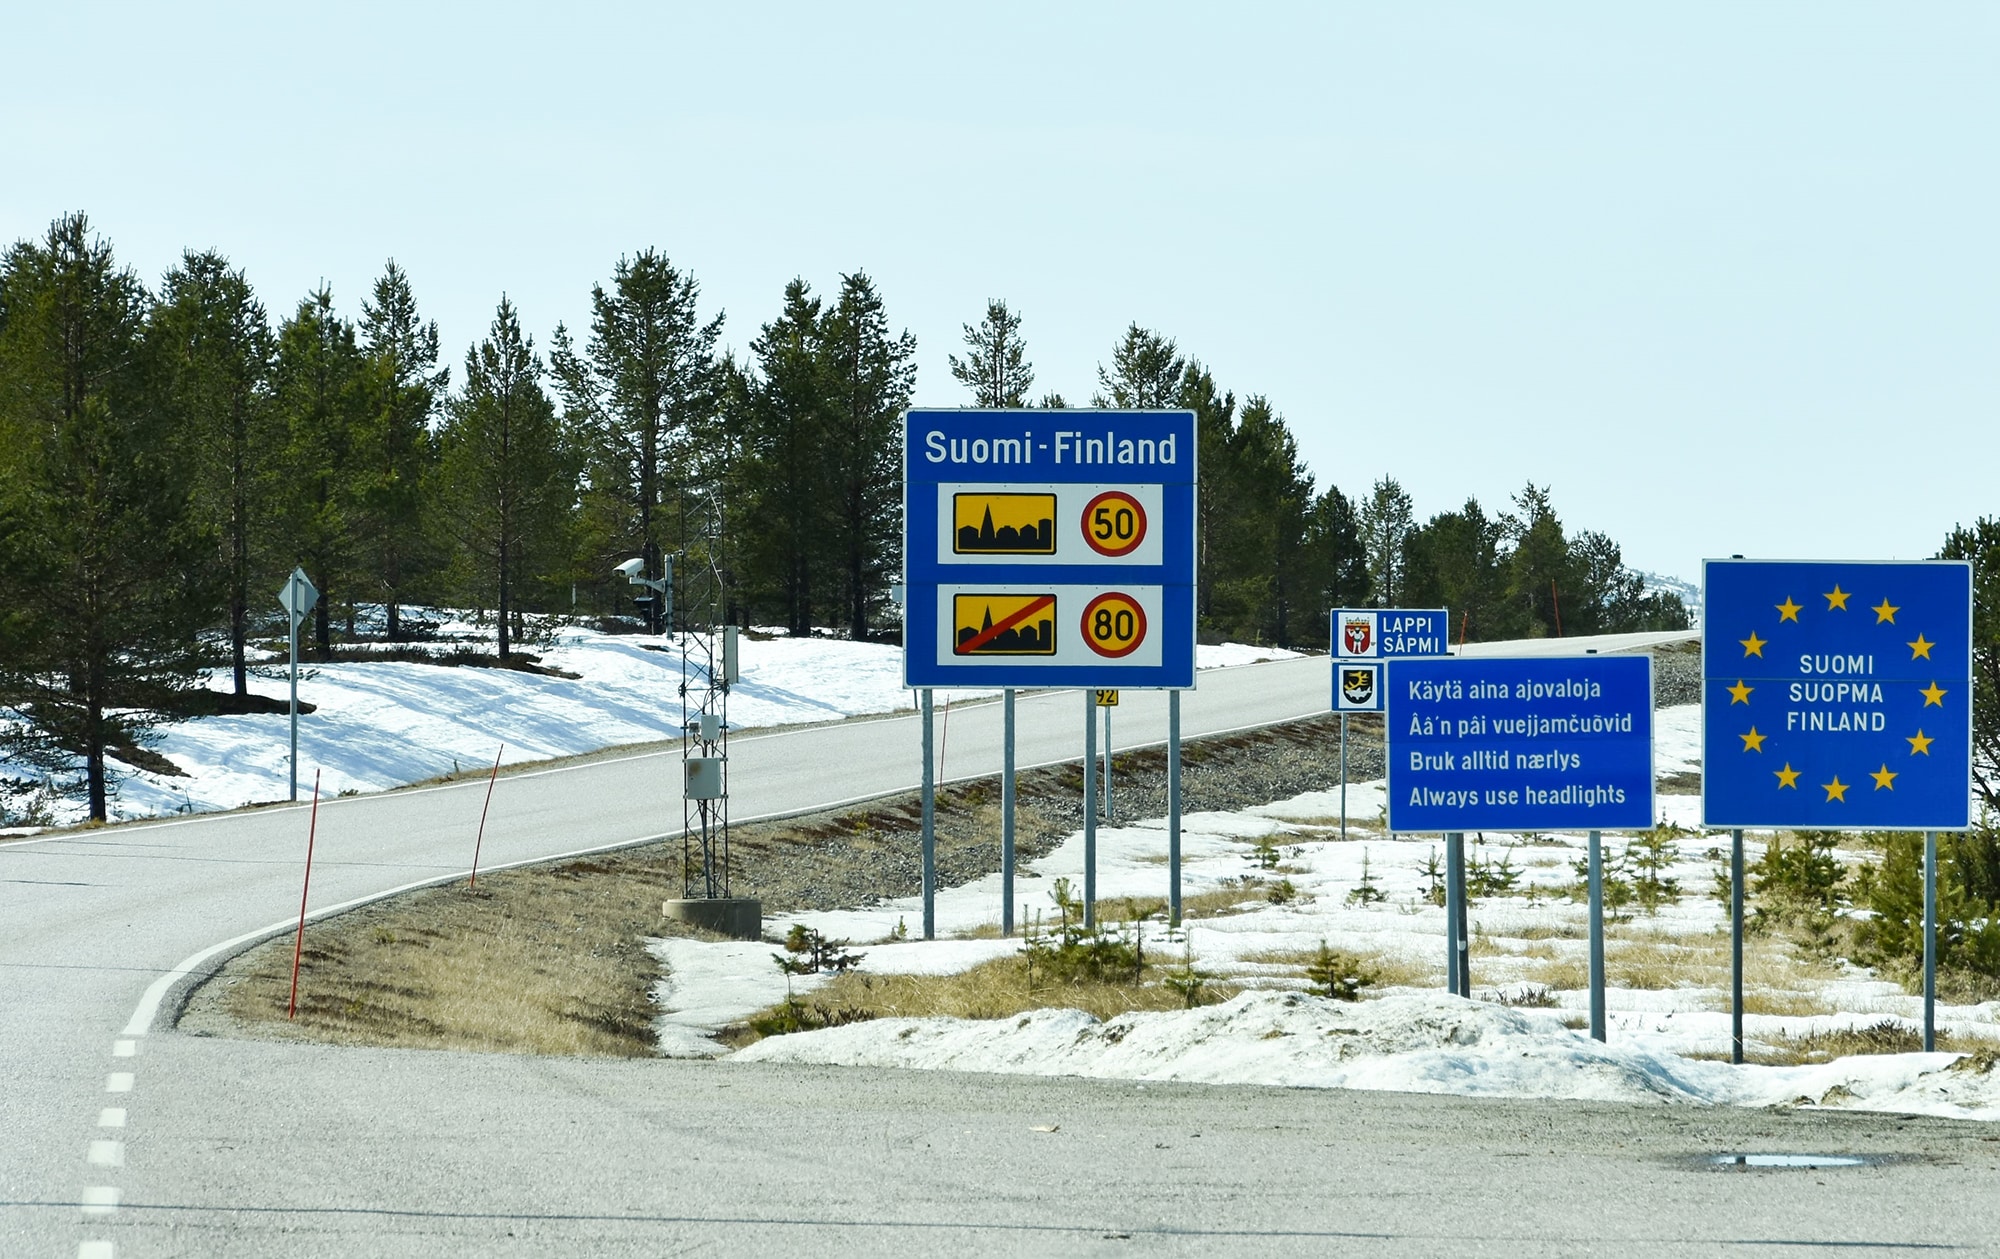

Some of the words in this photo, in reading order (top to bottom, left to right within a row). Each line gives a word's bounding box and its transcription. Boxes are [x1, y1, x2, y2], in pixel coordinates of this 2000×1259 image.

[1095, 508, 1134, 540] 50
[1094, 609, 1134, 641] 80
[1383, 617, 1432, 633] LAPPI
[1383, 634, 1439, 653] SÁPMI
[1799, 654, 1873, 675] SUOMI
[1096, 689, 1115, 704] 92
[1409, 680, 1462, 703] Käytä
[1469, 679, 1509, 699] aina
[1515, 678, 1601, 701] ajovaloja
[1789, 683, 1883, 703] SUOPMA
[1458, 715, 1486, 738] pâi
[1492, 713, 1632, 737] vuejjamčuõvid
[1787, 711, 1885, 732] FINLAND
[1410, 751, 1455, 771] Bruk
[1461, 750, 1509, 770] alltid
[1516, 749, 1581, 772] nærlys
[1409, 787, 1479, 809] Always
[1485, 790, 1519, 805] use
[1526, 784, 1625, 808] headlights
